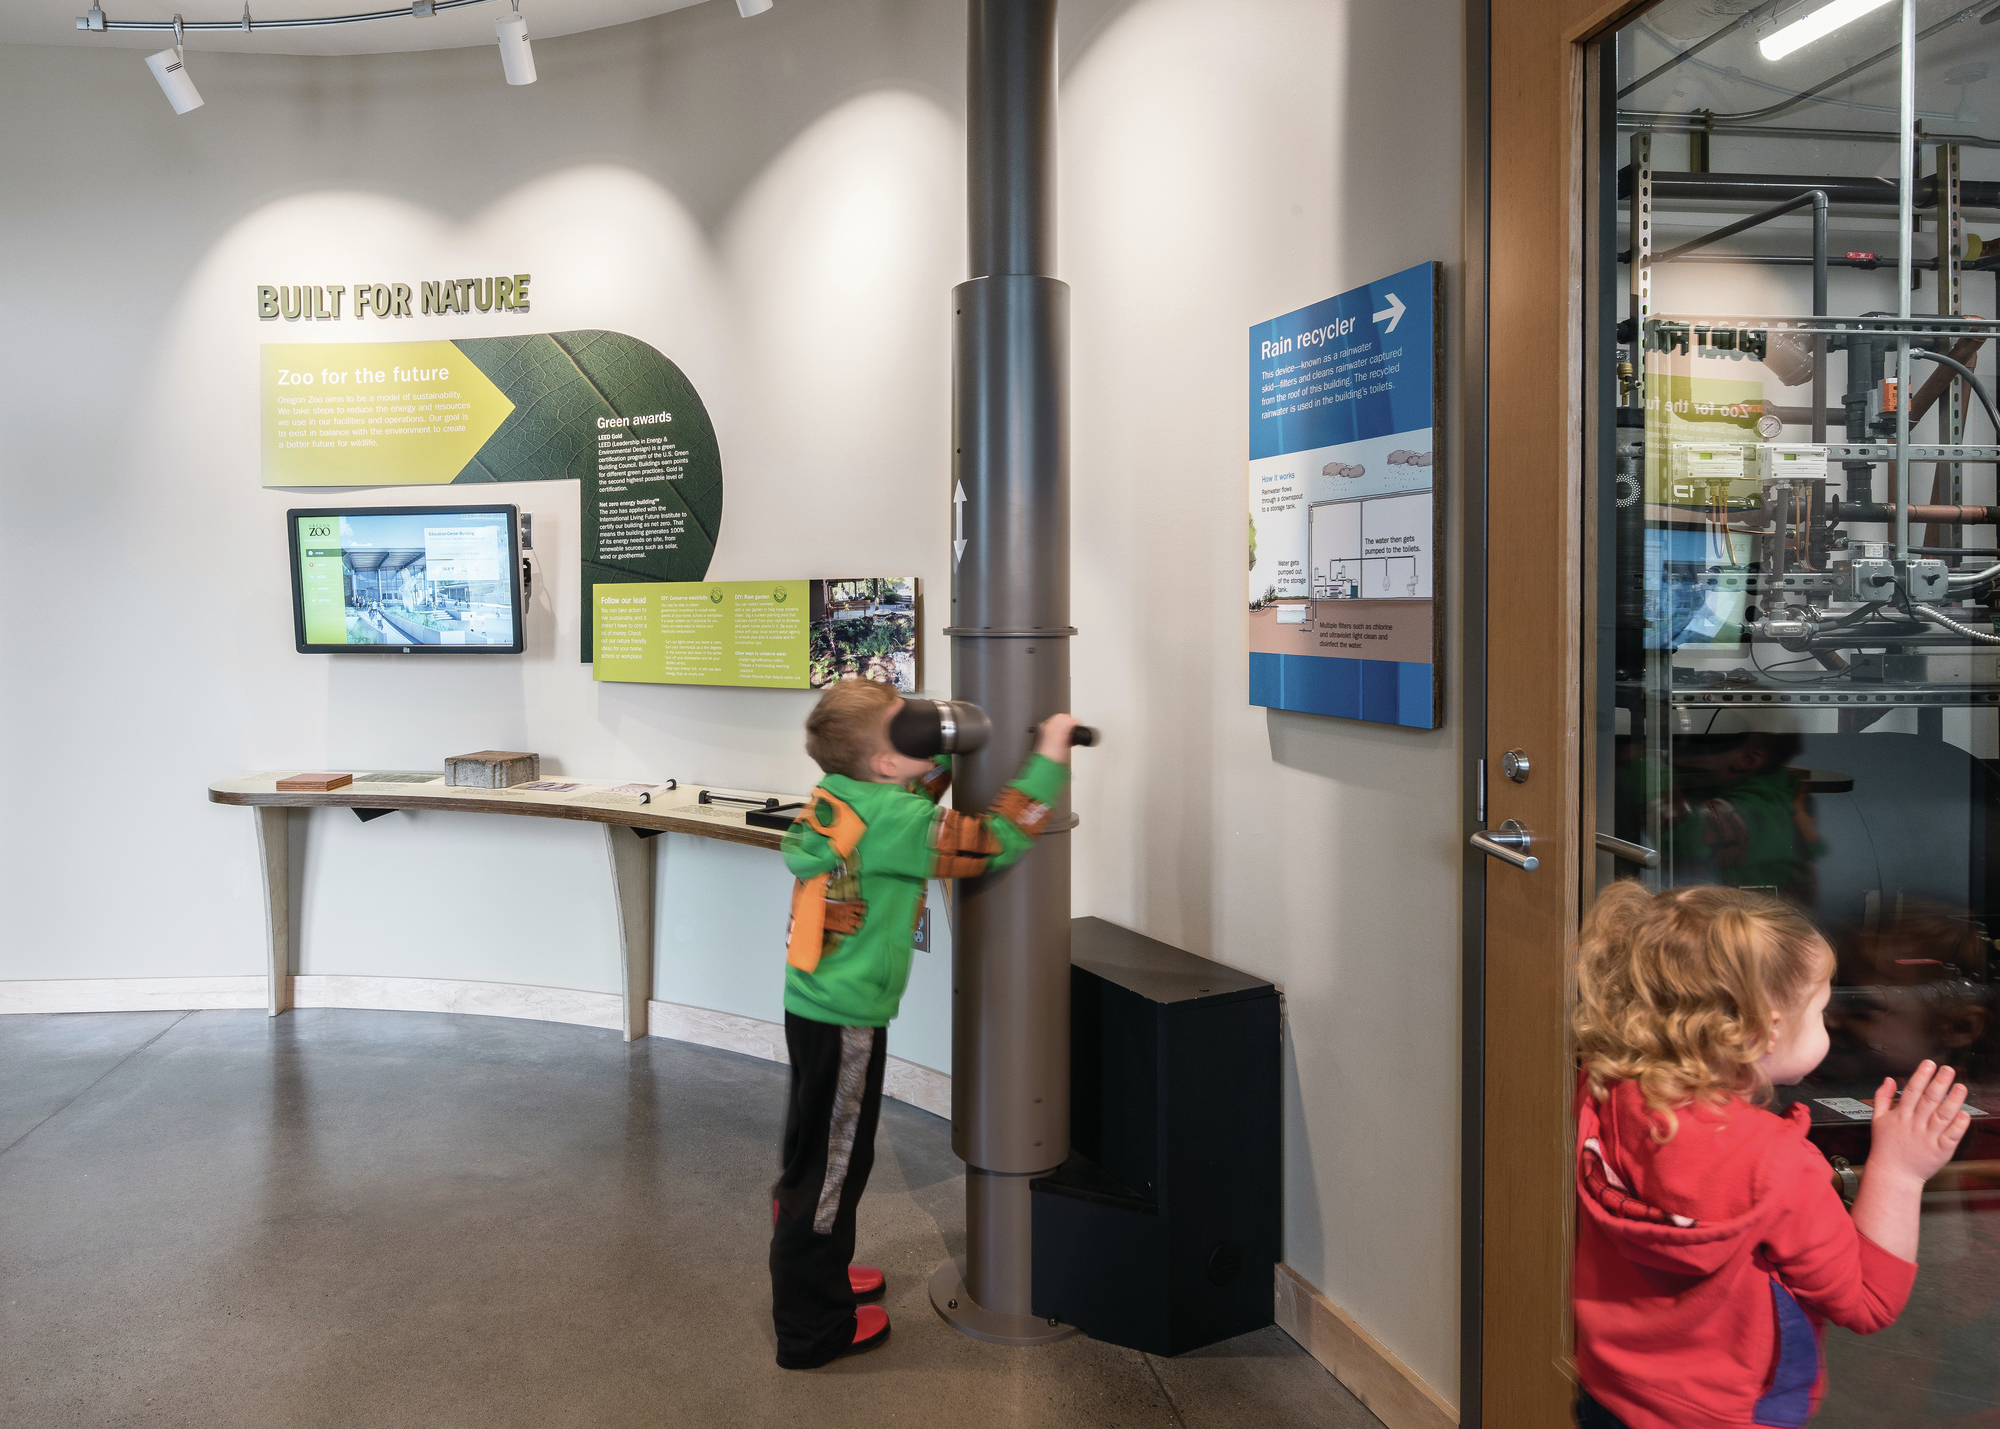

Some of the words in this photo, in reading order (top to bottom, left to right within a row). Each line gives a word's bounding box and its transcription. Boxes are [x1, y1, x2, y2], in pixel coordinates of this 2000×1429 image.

[257, 285, 345, 319] BUILT
[354, 283, 412, 318] FOR
[421, 274, 531, 315] NATURE
[1262, 335, 1291, 360] Rain
[1298, 318, 1355, 349] recycler
[1262, 369, 1273, 380] This
[1340, 343, 1372, 358] rainwater
[1299, 372, 1310, 383] and
[1313, 367, 1334, 379] cleans
[1336, 358, 1367, 373] rainwater
[1370, 347, 1402, 364] captured
[278, 370, 313, 385] Zoo
[321, 368, 347, 383] for
[355, 367, 385, 382] the
[393, 365, 449, 381] future
[1262, 396, 1275, 406] from
[1277, 393, 1286, 402] the
[1288, 388, 1300, 399] roof
[1310, 383, 1321, 394] this
[1324, 377, 1352, 390] building.
[1355, 372, 1367, 382] The
[1370, 363, 1399, 378] recycled
[278, 396, 305, 405] Oregon
[326, 394, 344, 402] aims
[377, 392, 399, 400] model
[413, 390, 461, 400] sustainability.
[1262, 406, 1288, 419] rainwater
[1298, 399, 1313, 411] used
[1322, 395, 1333, 405] the
[1370, 382, 1395, 394] toilets.
[278, 407, 290, 415] We
[313, 406, 334, 415] steps
[376, 404, 388, 412] the
[391, 405, 415, 413] energy
[309, 417, 316, 425] in
[334, 416, 365, 424] facilities
[368, 415, 382, 423] and
[385, 414, 426, 424] operations.
[445, 413, 459, 423] goal
[597, 417, 629, 428] Green
[633, 411, 671, 425] awards
[289, 429, 307, 437] exist
[319, 428, 349, 436] balance
[370, 426, 382, 434] the
[385, 425, 430, 433] environment
[443, 424, 466, 432] create
[286, 440, 309, 448] better
[338, 439, 348, 447] for
[612, 439, 640, 448] (Leadership
[599, 447, 631, 455] Environmental
[642, 468, 665, 476] practices.
[1279, 472, 1295, 481] works
[627, 476, 643, 484] highest
[645, 475, 665, 483] possible
[1262, 487, 1281, 495] Rainwater
[1262, 496, 1276, 504] through
[1281, 493, 1303, 502] downspout
[309, 527, 330, 536] ZOO
[1403, 535, 1415, 544] gets
[1365, 546, 1385, 555] pumped
[1290, 559, 1299, 567] gets
[1278, 569, 1294, 577] pumped
[1320, 622, 1337, 630] Multiple
